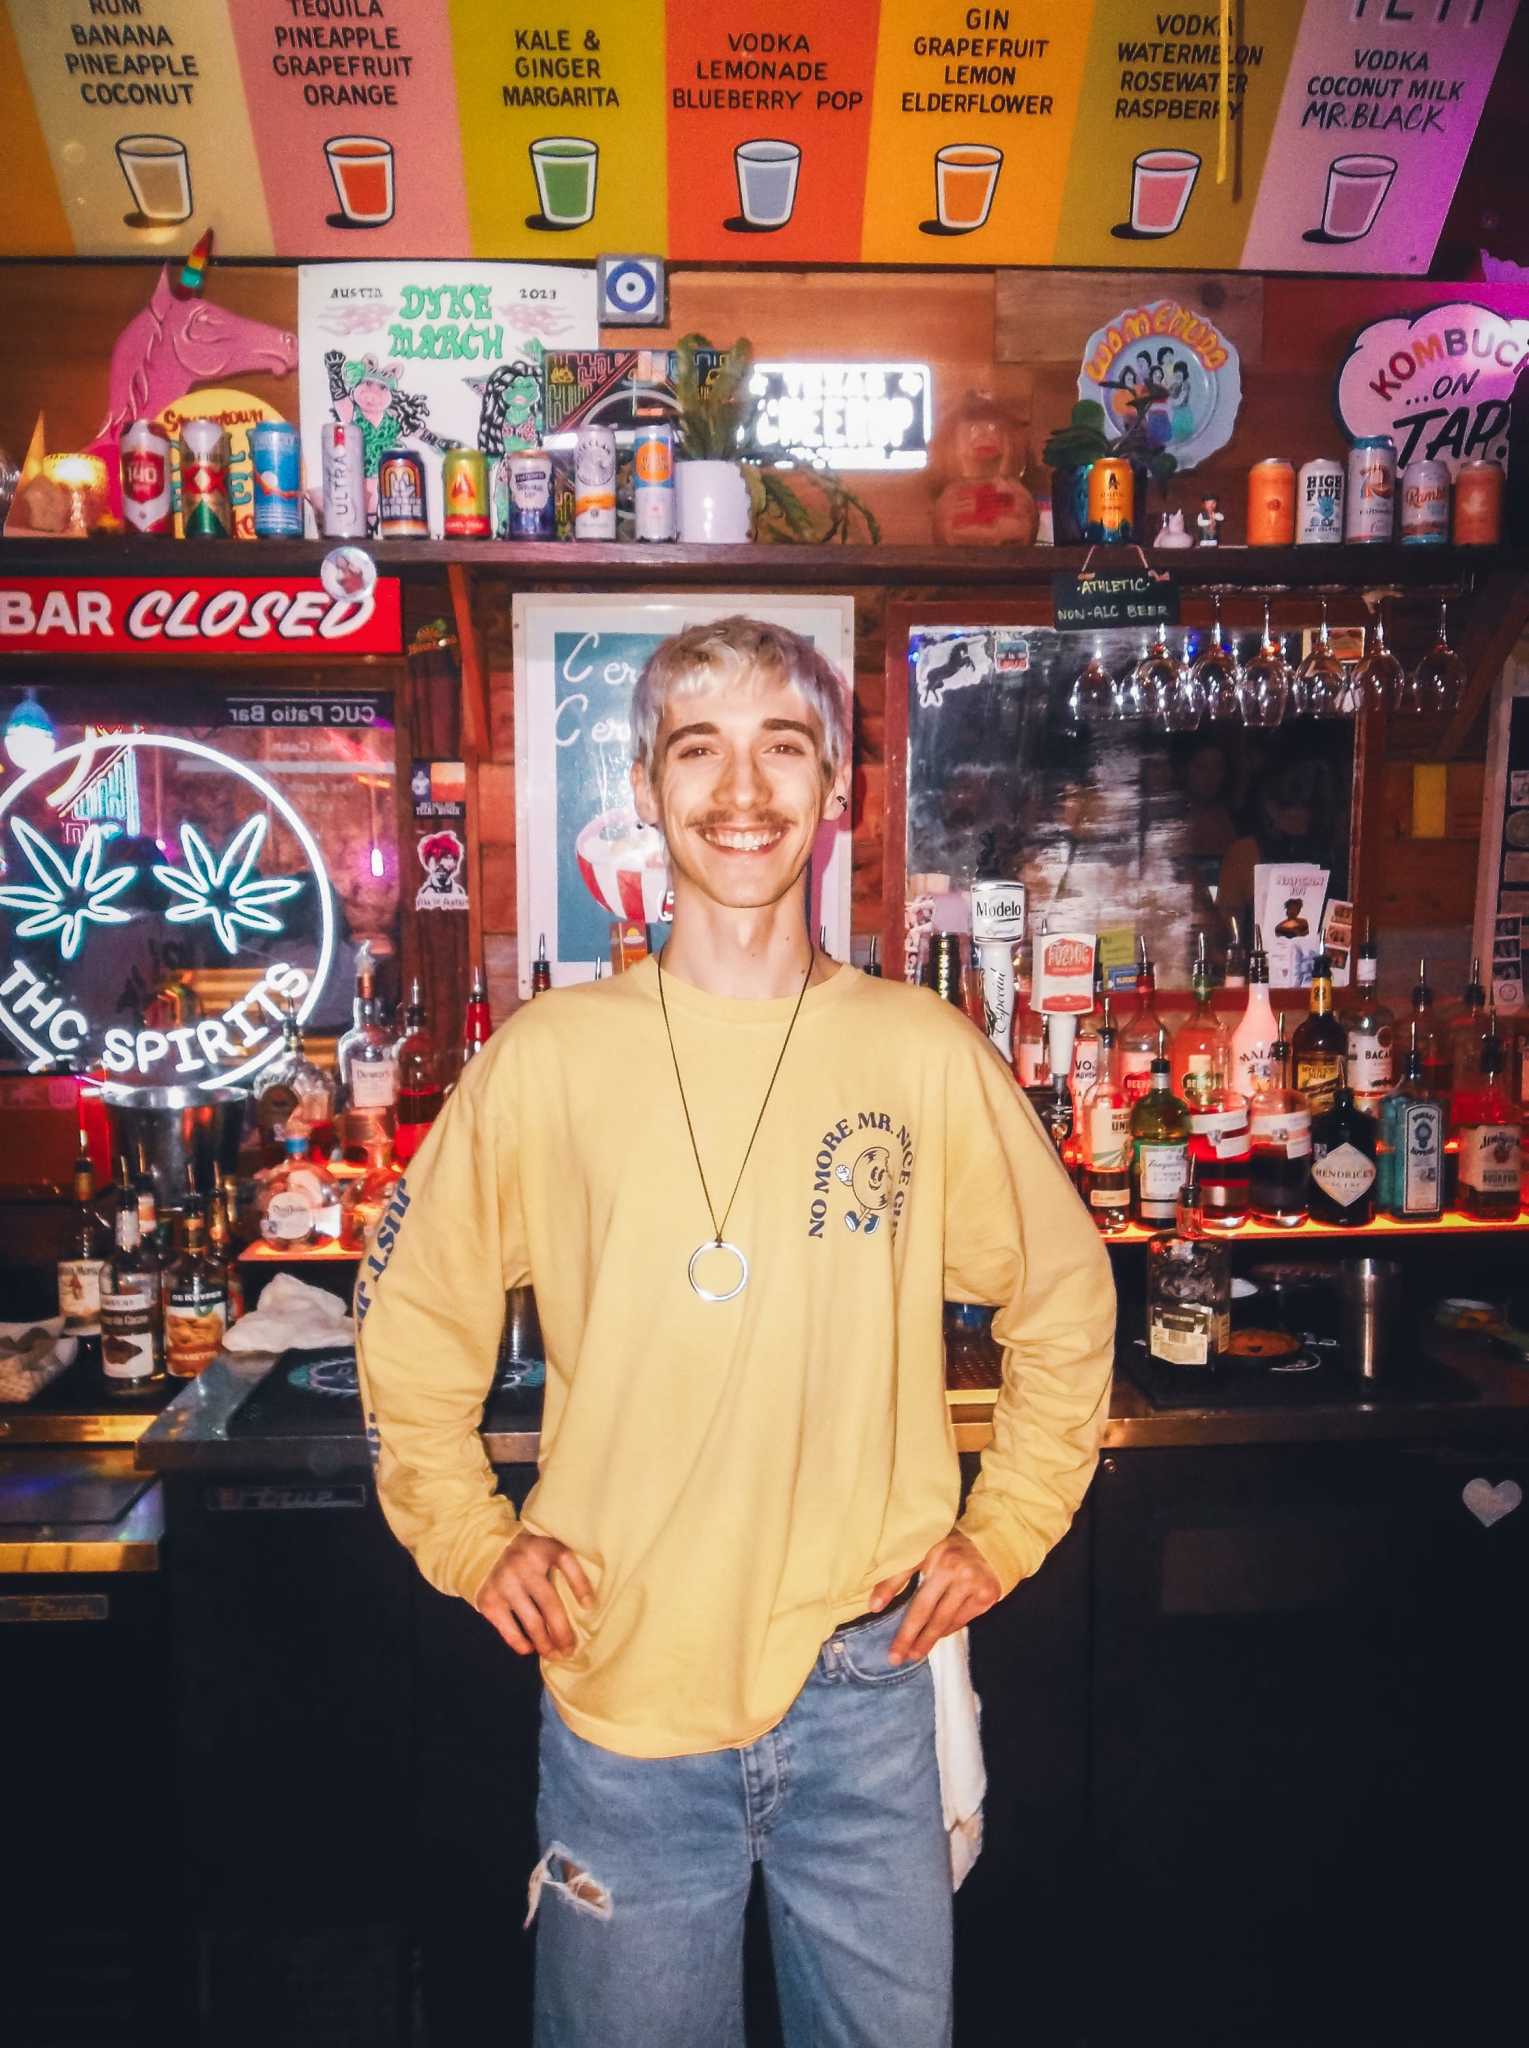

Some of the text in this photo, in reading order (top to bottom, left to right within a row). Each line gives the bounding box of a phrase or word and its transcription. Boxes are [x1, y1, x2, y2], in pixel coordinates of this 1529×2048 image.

[90, 0, 142, 16] RUM
[287, 0, 384, 18] TEQUILA
[966, 8, 1010, 30] GIN
[72, 25, 174, 46] BANANA
[275, 27, 400, 49] PINEAPPLE
[515, 30, 601, 51] KALE &
[728, 33, 810, 53] VODKA
[913, 36, 1049, 58] GRAPEFRUIT
[65, 55, 199, 77] PINEAPPLE
[272, 56, 412, 77] GRAPEFRUIT
[514, 57, 601, 78] GINGER
[696, 61, 828, 81] LEMONADE
[1353, 49, 1429, 71] VODKA
[944, 65, 1016, 85] LEMON
[1120, 70, 1248, 93] ROSEWATER
[80, 83, 193, 105] COCONUT
[303, 84, 398, 106] ORANGE
[502, 86, 620, 108] MARGARITA
[672, 88, 863, 111] BLUEBERRY POP
[1307, 76, 1464, 101] COCONUT MILK
[901, 92, 1053, 114] ELDERFLOWER
[330, 287, 383, 299] AUSTIN
[399, 282, 493, 320] DYKE
[388, 323, 504, 360] MARCH
[333, 455, 348, 515] ULTRA
[1306, 475, 1342, 489] HIGH
[0, 590, 114, 636] BAR
[127, 588, 376, 640] CLOSED
[1057, 604, 1168, 620] NON-ALC BEER
[976, 901, 1021, 918] Modelo
[0, 960, 87, 1049] THC
[103, 962, 309, 1074] SPIRITS
[858, 1112, 894, 1135] MR.
[814, 1118, 853, 1194] MORE
[896, 1125, 914, 1186] NICE
[808, 1199, 828, 1239] NO
